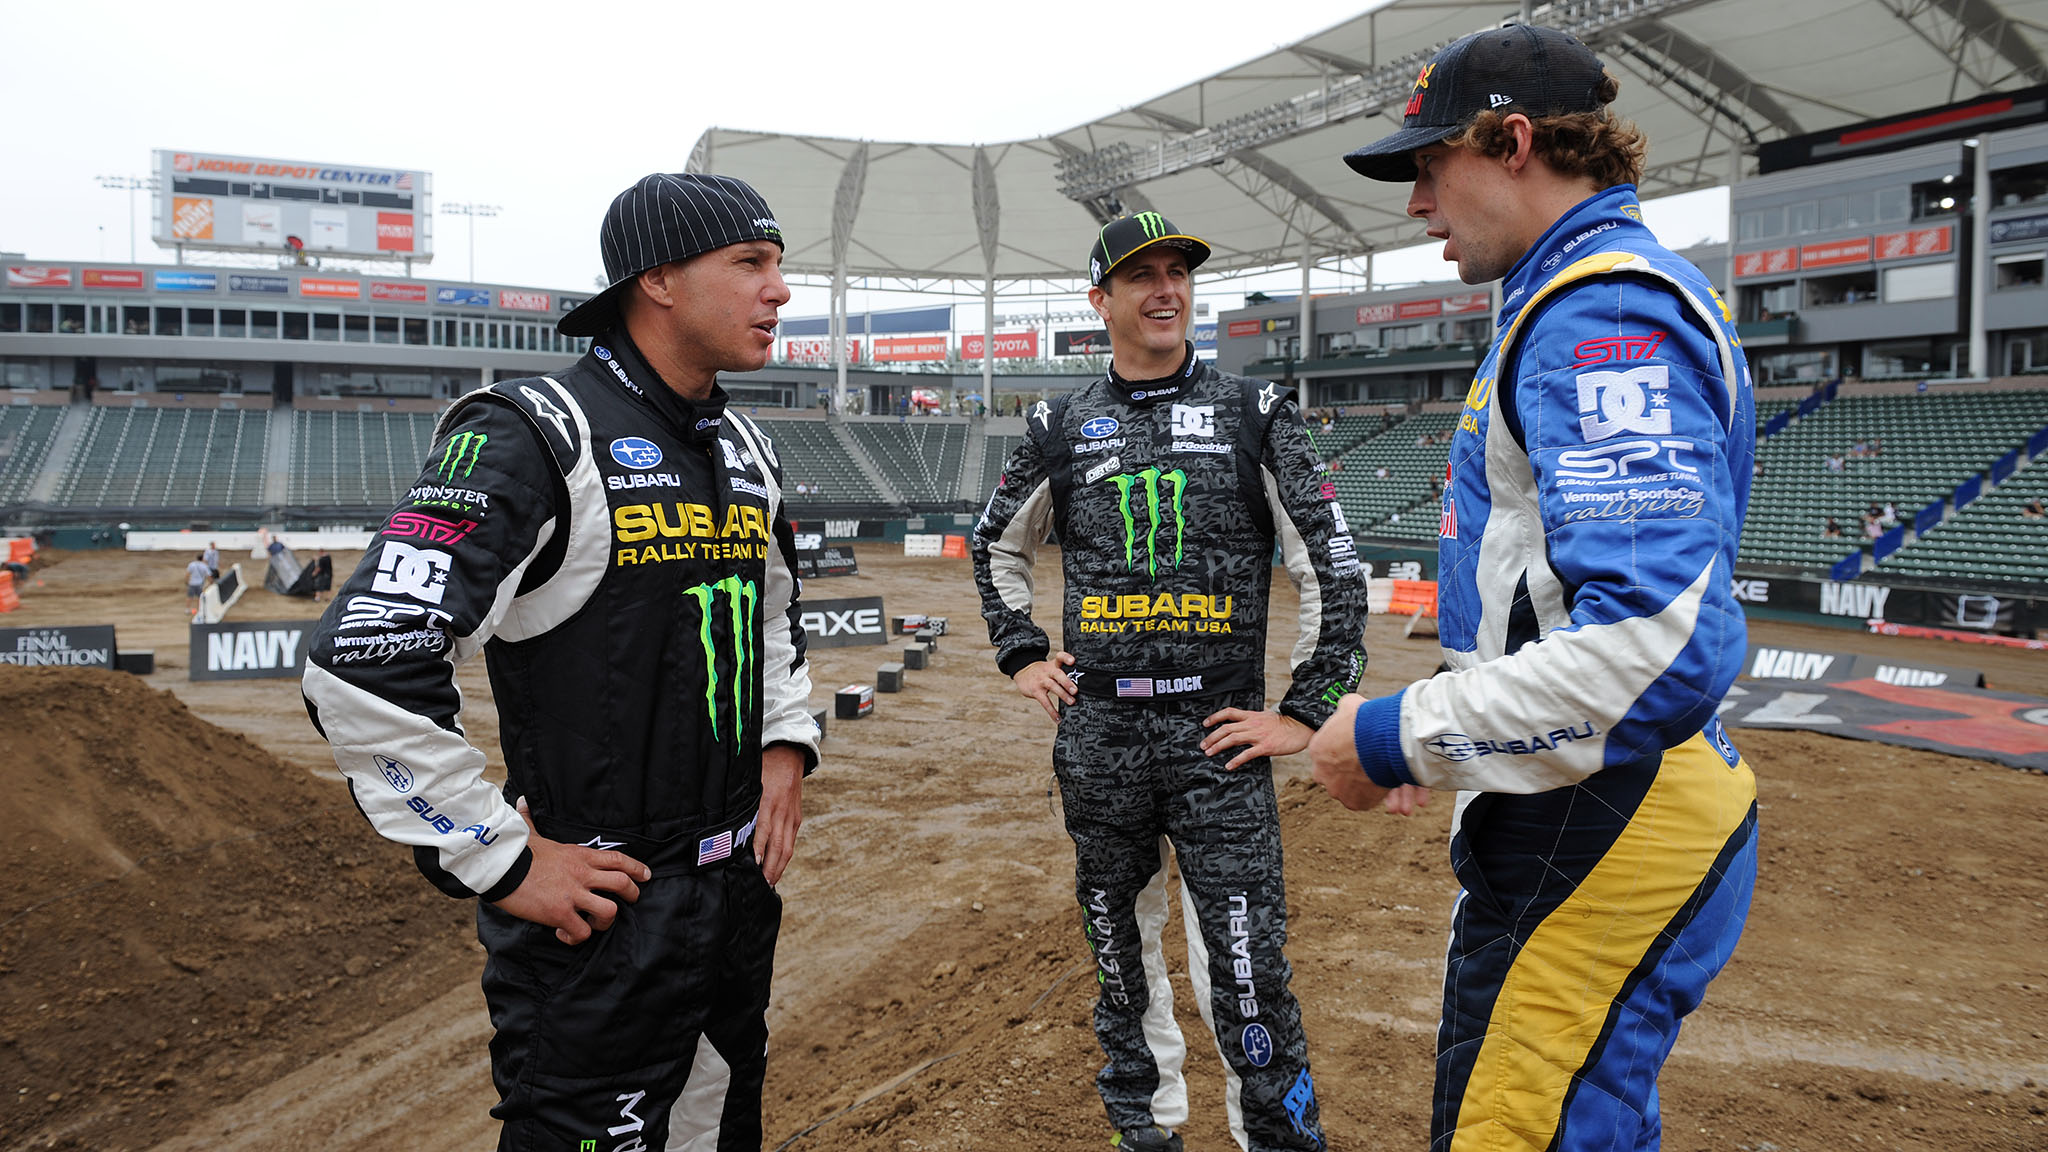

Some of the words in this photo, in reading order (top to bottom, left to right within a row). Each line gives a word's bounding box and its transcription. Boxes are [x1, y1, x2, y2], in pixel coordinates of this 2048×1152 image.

[196, 158, 253, 174] HOME
[253, 161, 320, 179] DEPOT
[319, 168, 393, 186] CENTER
[1562, 220, 1617, 254] SUBARU
[993, 339, 1030, 352] OYOTA
[607, 359, 644, 398] SUBARU
[1146, 385, 1180, 398] SUBARU
[1074, 437, 1127, 454] SUBARU
[1170, 441, 1233, 454] BFGoodrich
[607, 472, 681, 491] SUBARU
[1555, 477, 1598, 488] SUBARU
[407, 483, 490, 509] MONSTER
[1561, 489, 1626, 505] Vermont
[1627, 486, 1704, 501] SportsCar
[613, 501, 771, 543] SUBARU
[1563, 498, 1707, 525] rallying
[825, 520, 861, 538] NAVY
[616, 542, 698, 567] RALLY
[1731, 579, 1769, 602] XE
[1819, 582, 1892, 619] NAVY
[1080, 592, 1233, 620] SUBARU
[801, 608, 882, 637] AXE
[1080, 621, 1129, 634] RALLY
[1132, 619, 1189, 633] TEAM
[1195, 621, 1233, 634] USA
[17, 634, 72, 652] FINAL
[207, 629, 303, 672] NAVY
[332, 636, 446, 667] rallying
[334, 633, 386, 648] Vermont
[1750, 648, 1835, 681] NAVY
[1155, 675, 1204, 695] BLOCK
[1472, 721, 1594, 757] SUBARU
[1089, 887, 1130, 1010] MONSTE
[1229, 895, 1259, 1018] SUBARU
